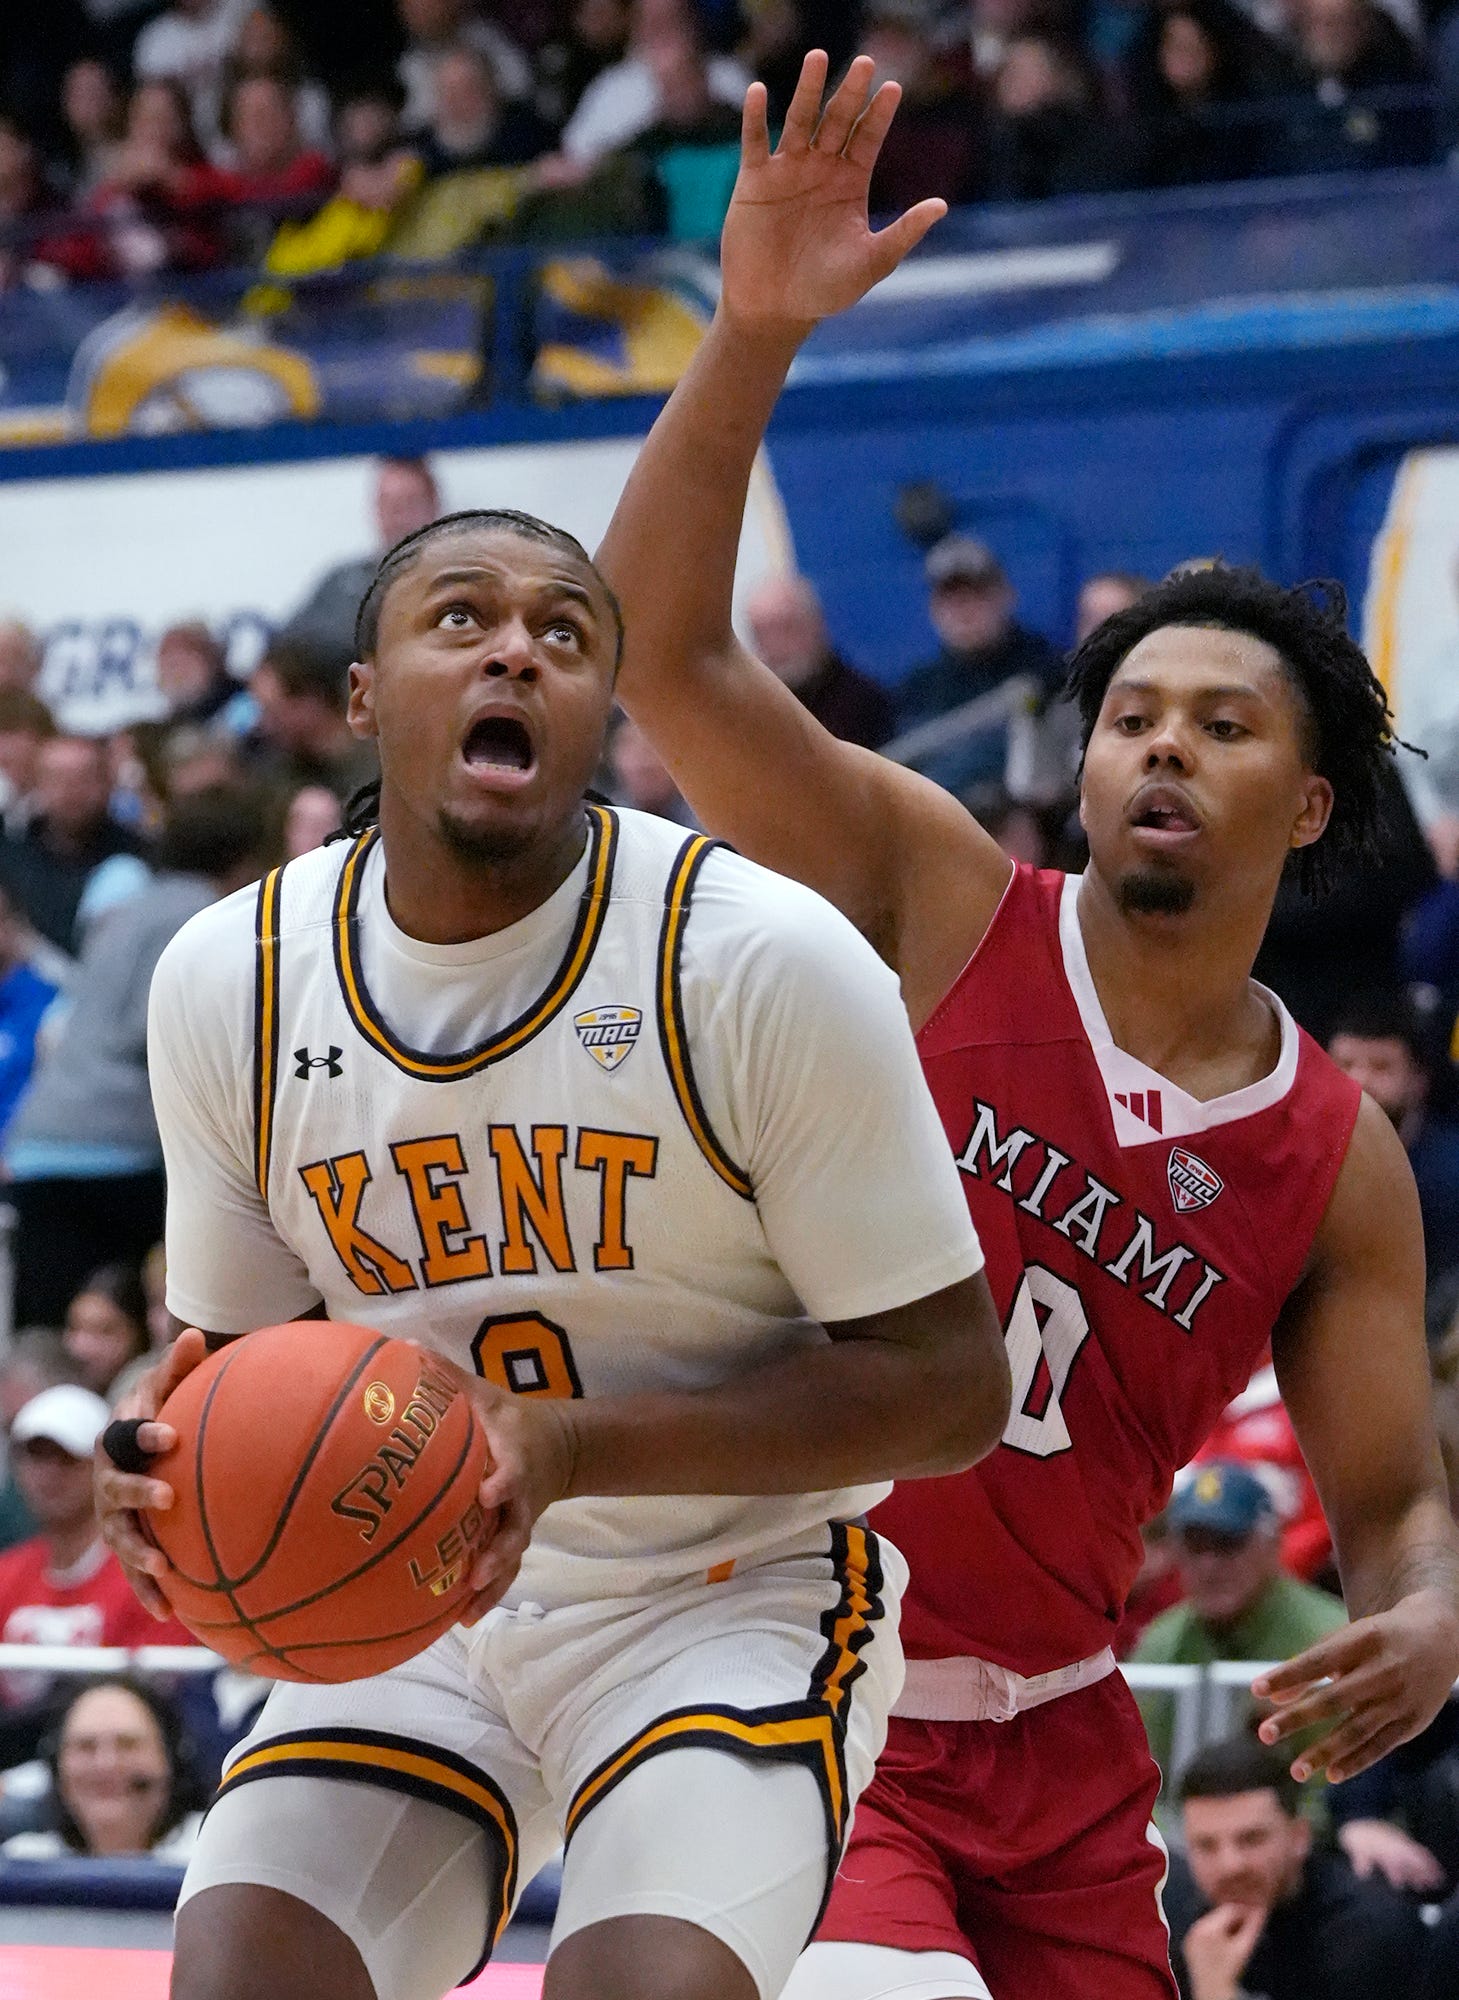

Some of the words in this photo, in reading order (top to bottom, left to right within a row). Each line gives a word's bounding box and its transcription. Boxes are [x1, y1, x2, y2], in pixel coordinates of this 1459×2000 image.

[579, 1023, 640, 1045] MAC
[297, 1124, 659, 1295] KENT
[955, 1097, 1228, 1334] MIAMI
[1169, 1161, 1216, 1204] MAC
[1000, 1259, 1091, 1461] 0
